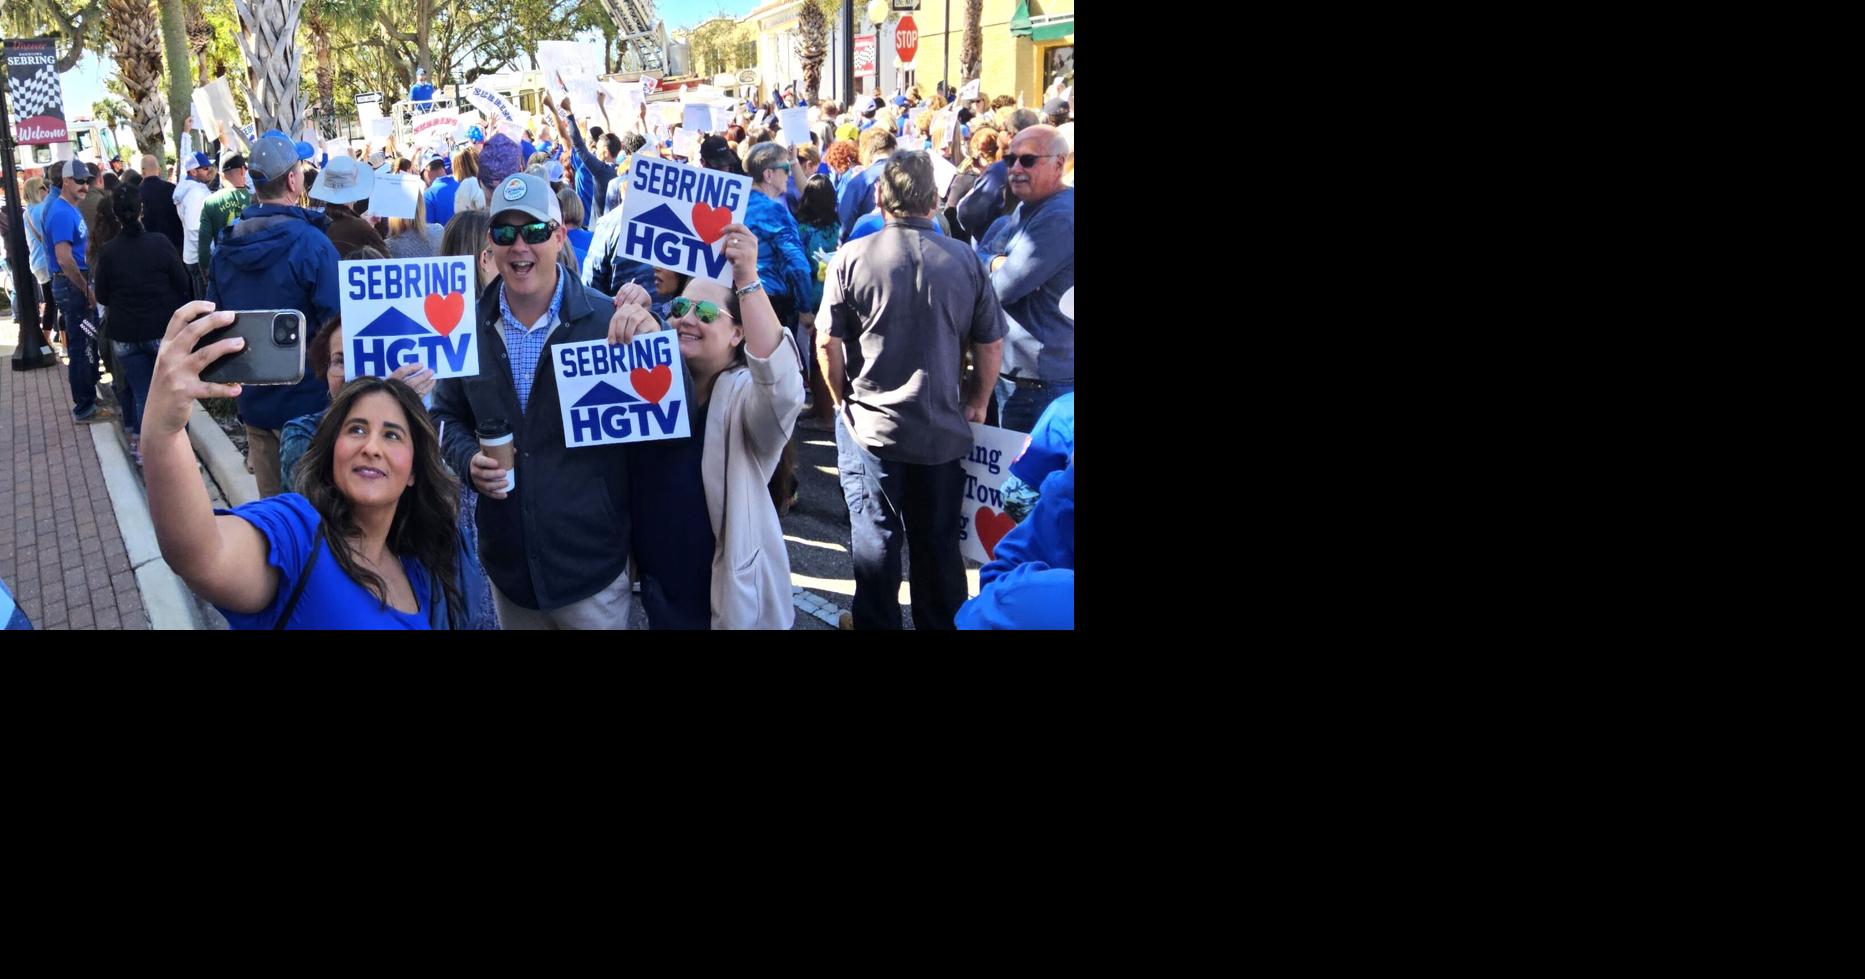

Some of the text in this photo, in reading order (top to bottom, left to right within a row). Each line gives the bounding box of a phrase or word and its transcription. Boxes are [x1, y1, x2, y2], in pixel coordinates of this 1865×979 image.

[896, 30, 917, 48] STOP
[7, 56, 55, 66] SEBRING
[17, 125, 67, 141] Welcome
[633, 159, 742, 213] SEBRING
[625, 221, 728, 280] HGTV
[348, 261, 467, 301] SEBRING
[352, 332, 472, 377] HGTV
[560, 336, 672, 378] SEBRING
[570, 400, 681, 443] HGTV
